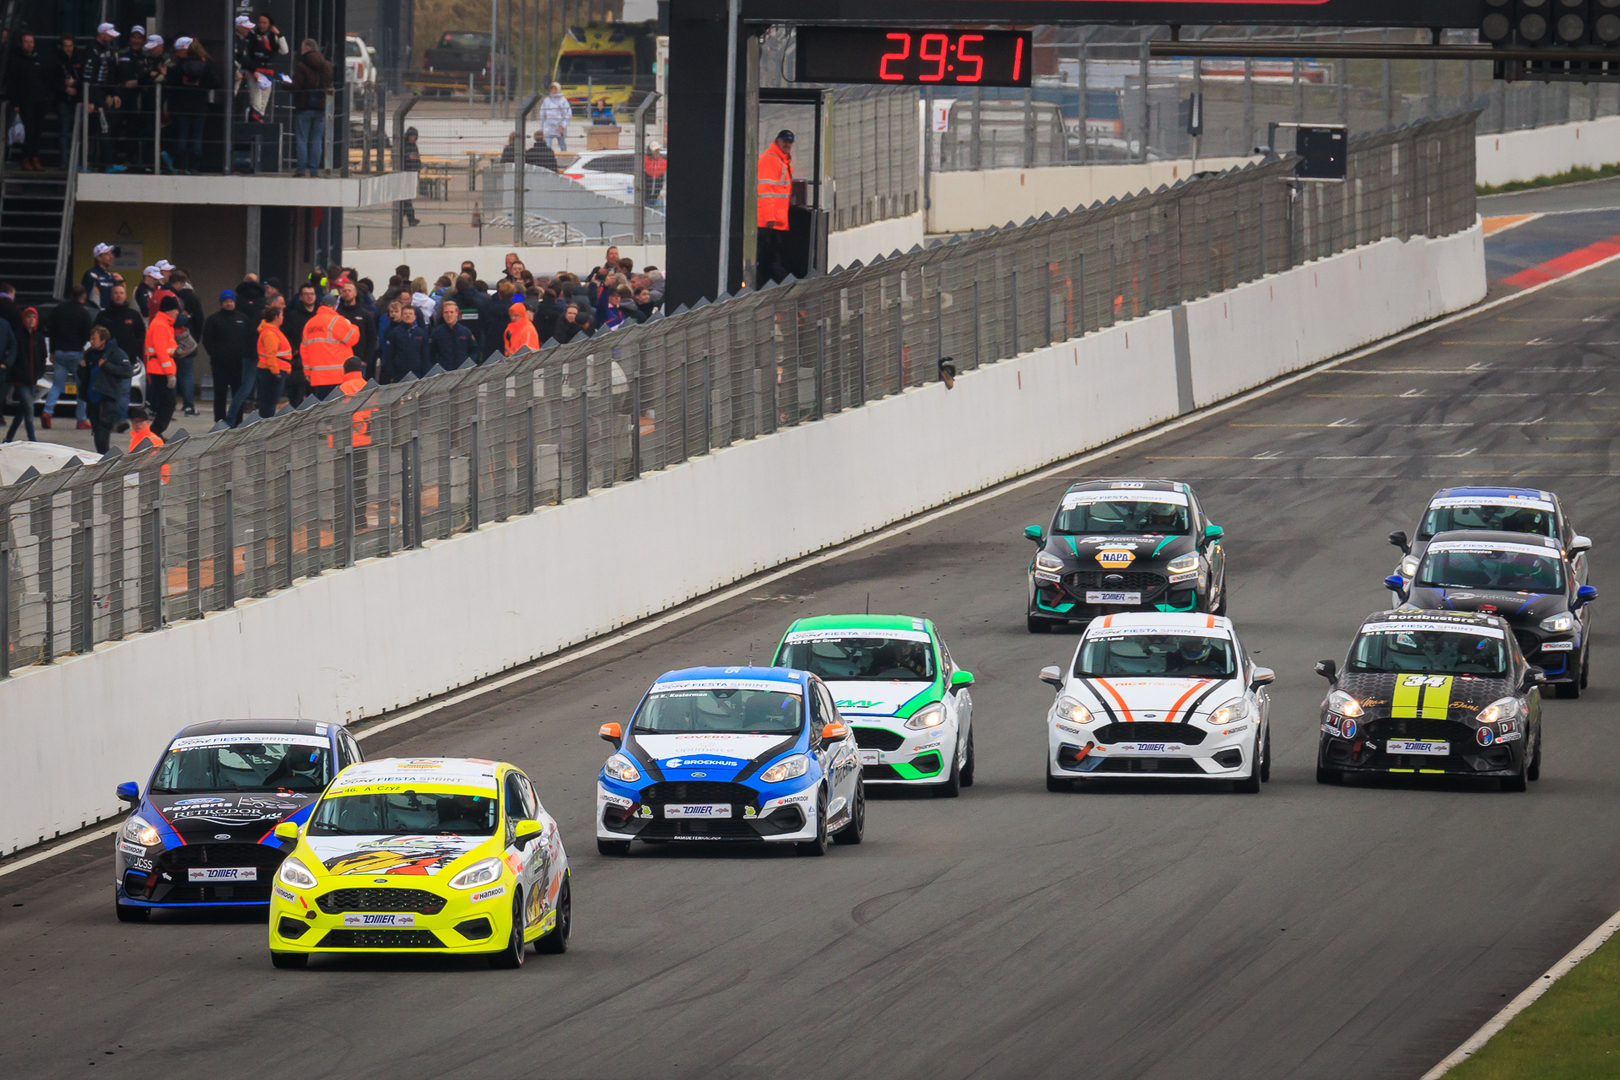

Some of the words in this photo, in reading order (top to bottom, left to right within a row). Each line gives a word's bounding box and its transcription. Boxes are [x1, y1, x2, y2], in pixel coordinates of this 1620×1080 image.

[879, 32, 1024, 82] 29:51
[1102, 553, 1128, 561] NAPA
[1388, 614, 1475, 623] Bordbusters
[1402, 675, 1447, 687] 34
[1137, 743, 1165, 752] ZOMER
[1404, 742, 1432, 752] ZOMER
[174, 808, 263, 819] RETRODOR
[682, 805, 713, 815] ZOMER
[134, 858, 153, 869] JCSS
[206, 869, 239, 879] ZOMER
[362, 914, 396, 925] ZOMER
